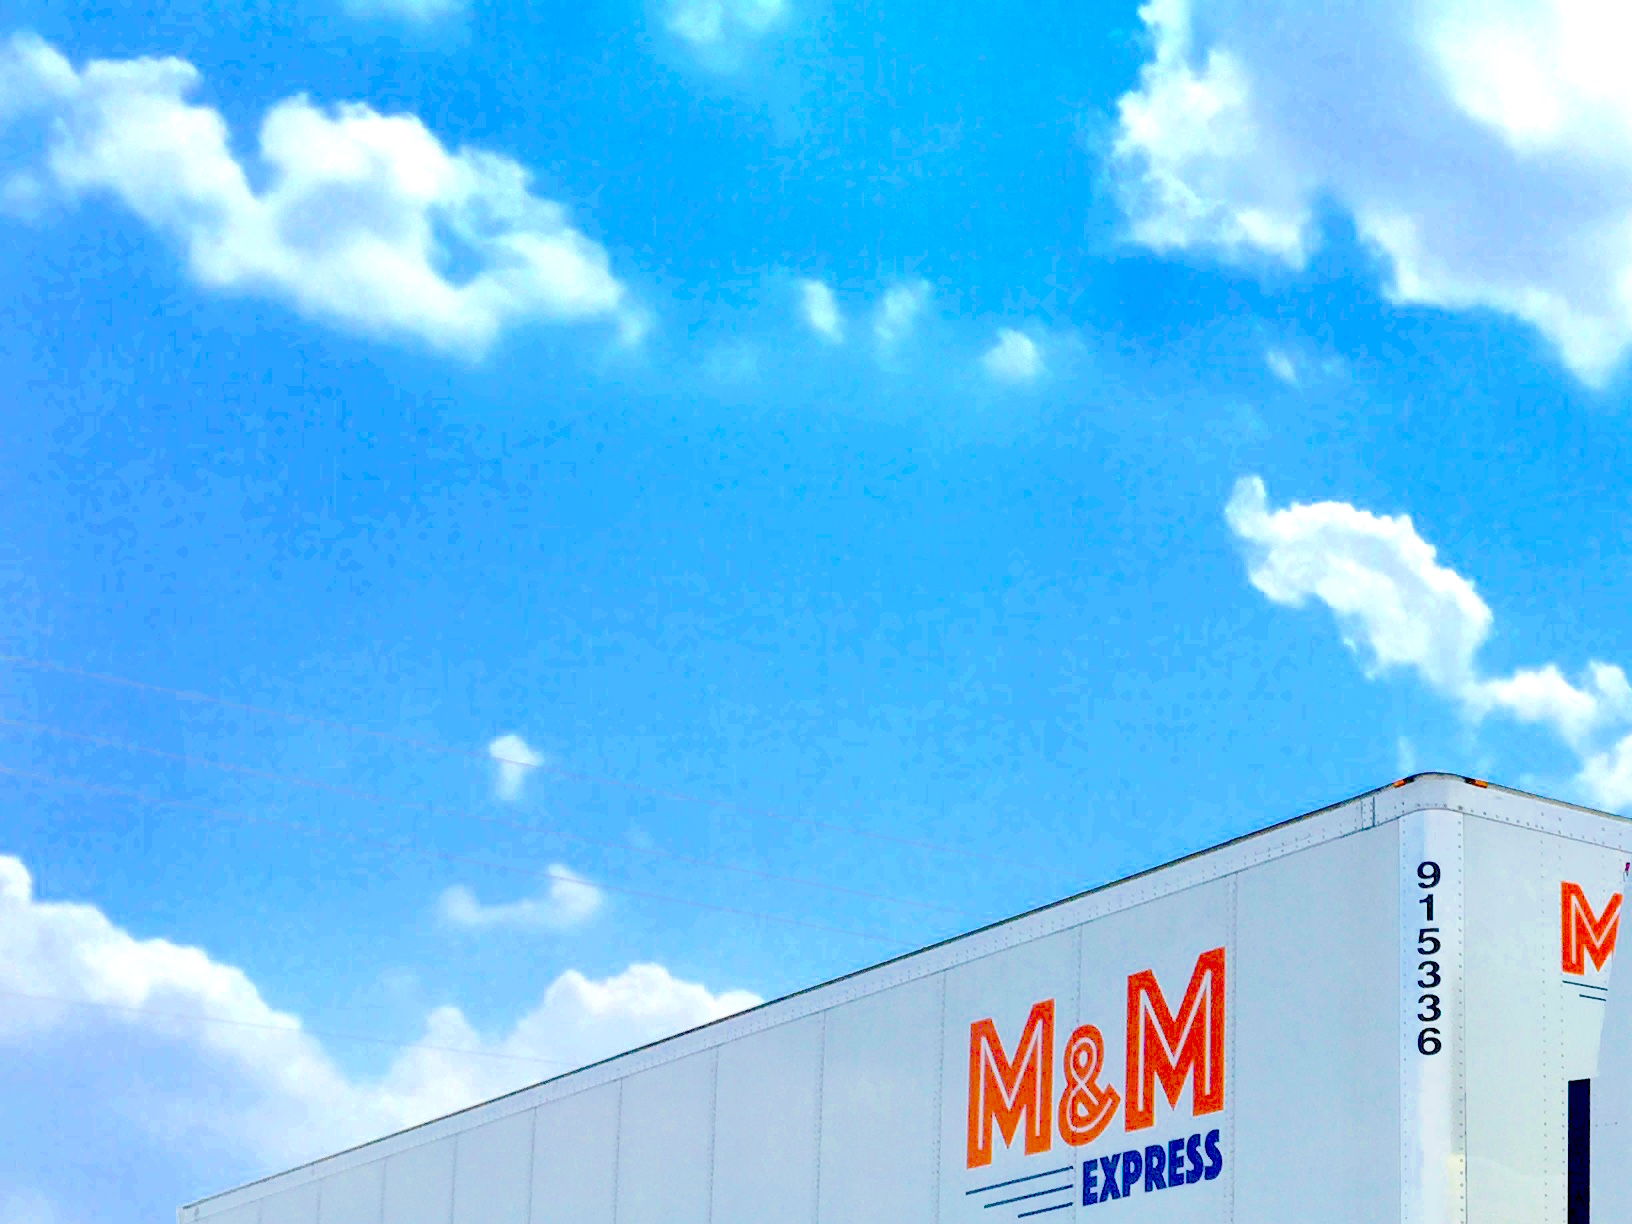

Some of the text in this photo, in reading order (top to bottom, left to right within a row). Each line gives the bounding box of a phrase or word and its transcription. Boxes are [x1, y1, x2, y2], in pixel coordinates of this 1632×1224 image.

[1417, 861, 1442, 1056] 915336
[966, 946, 1226, 1170] M&M
[1082, 1129, 1223, 1206] EXPRESS
